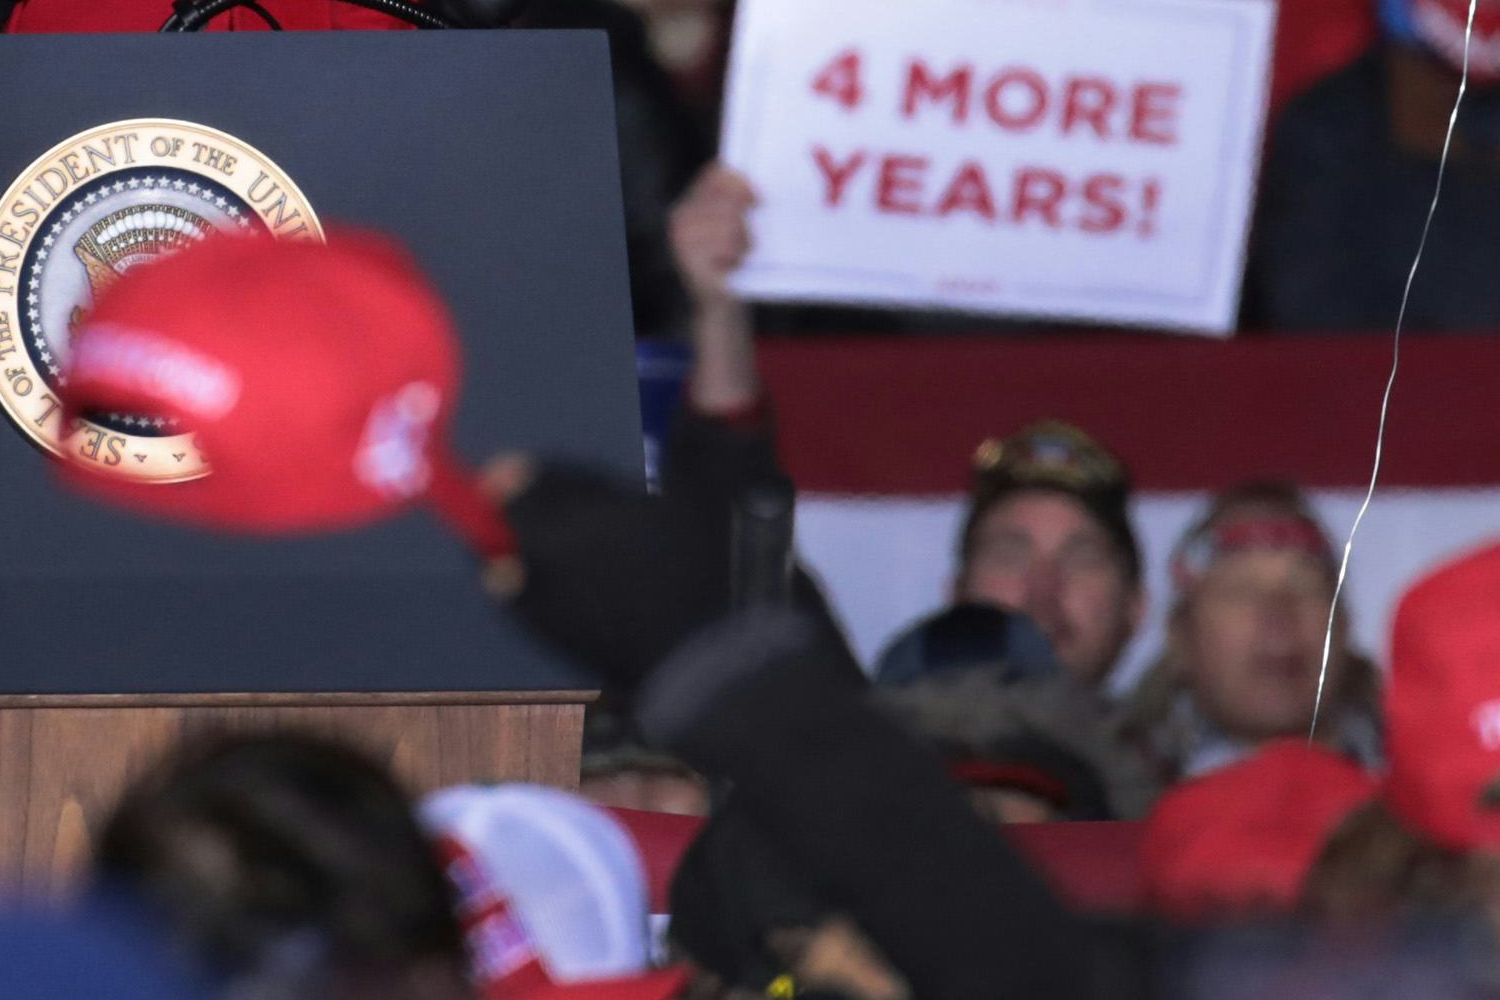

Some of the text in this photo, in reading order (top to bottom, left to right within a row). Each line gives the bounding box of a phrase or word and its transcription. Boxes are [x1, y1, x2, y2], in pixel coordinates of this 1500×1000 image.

[811, 47, 1182, 146] 4 MORE
[150, 135, 184, 158] OF
[192, 143, 238, 176] THE
[247, 169, 309, 237] UNI
[811, 145, 1161, 239] YEARS!
[4, 366, 33, 397] OF
[34, 393, 127, 467] SEL
